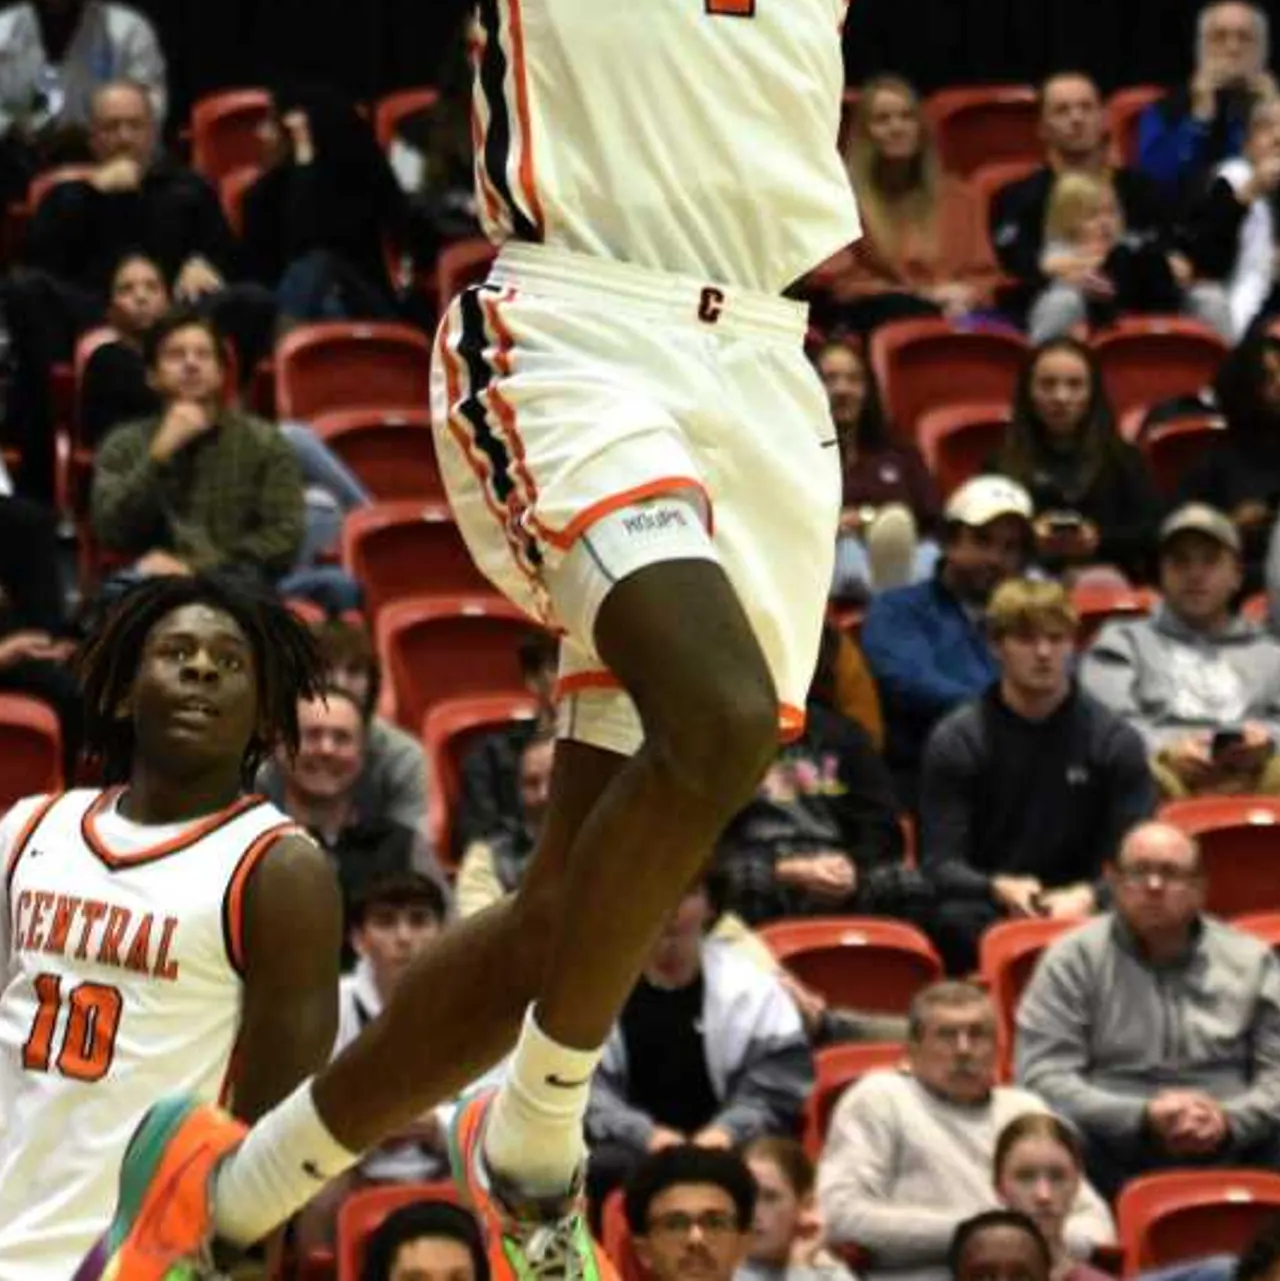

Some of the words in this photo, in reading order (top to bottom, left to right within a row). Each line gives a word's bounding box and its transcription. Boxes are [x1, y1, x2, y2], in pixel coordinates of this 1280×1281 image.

[698, 287, 724, 324] C
[16, 889, 179, 982] CENTRAL
[23, 972, 123, 1083] 10
